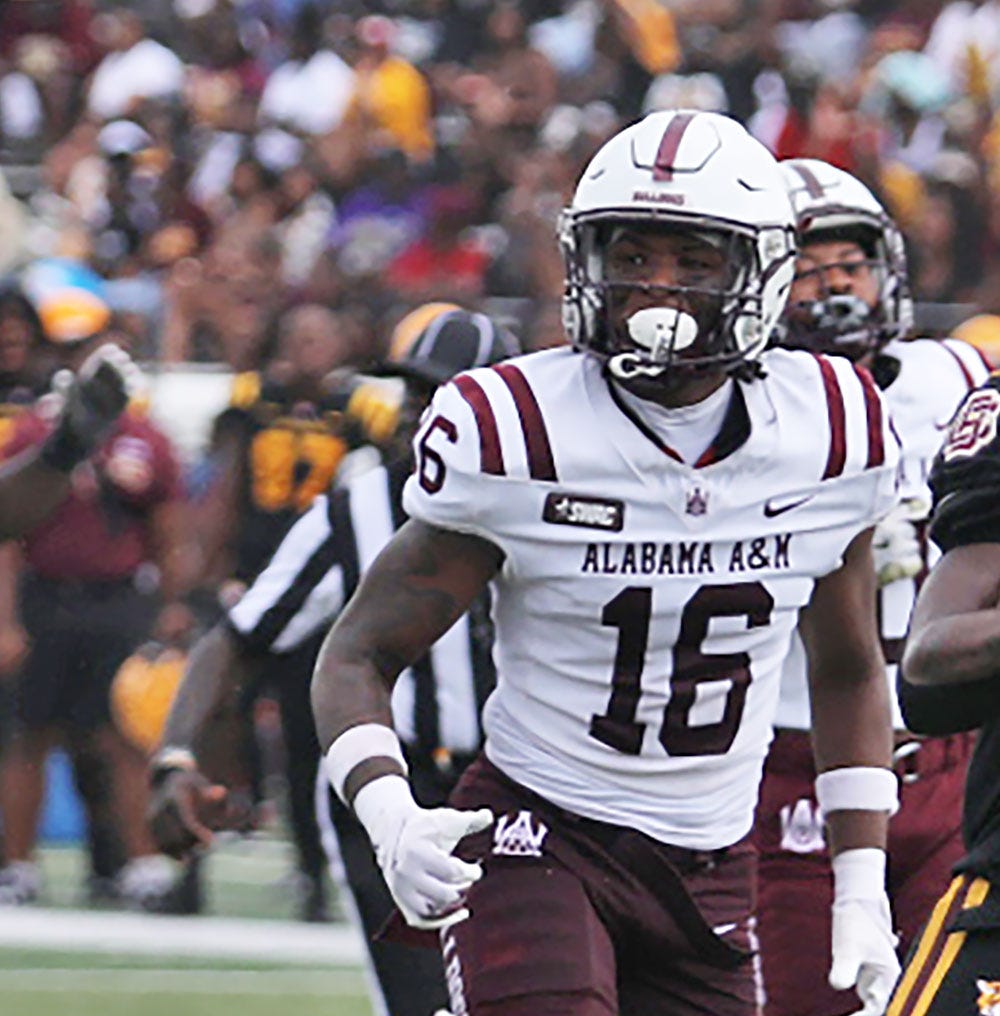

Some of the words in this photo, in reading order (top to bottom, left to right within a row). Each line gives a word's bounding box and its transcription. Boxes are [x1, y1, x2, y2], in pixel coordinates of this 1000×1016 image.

[413, 414, 458, 495] 6
[581, 542, 714, 574] ALABAMA
[728, 533, 792, 571] A&M
[588, 580, 774, 757] 16
